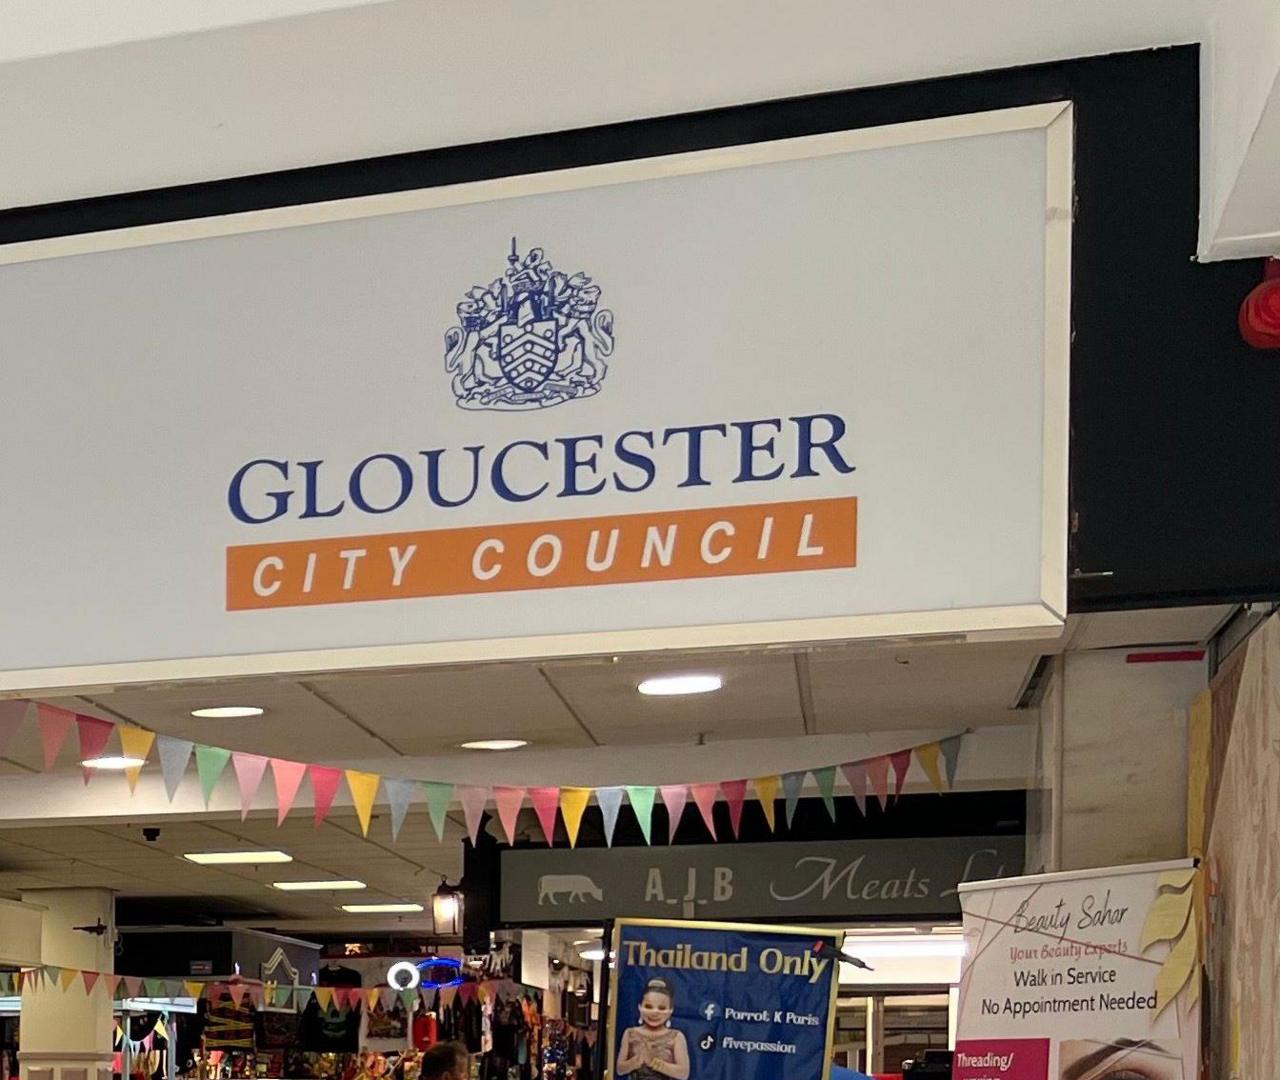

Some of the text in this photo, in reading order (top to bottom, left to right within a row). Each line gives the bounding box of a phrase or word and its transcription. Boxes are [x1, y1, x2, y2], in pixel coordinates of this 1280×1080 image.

[226, 411, 856, 526] GLOUCESTER
[252, 513, 826, 598] CITY COUNCIL
[769, 856, 930, 901] Meats
[1014, 889, 1128, 943] Beauty Sahar
[622, 940, 828, 984] Thailand Only
[1010, 945, 1038, 963] Your
[1040, 942, 1083, 963] Beauty
[1013, 966, 1117, 988] Walk in Service
[724, 1006, 820, 1027] Parrot K Paris
[1003, 990, 1158, 1019] Appointment Needed
[956, 1052, 1015, 1072] Threading/
